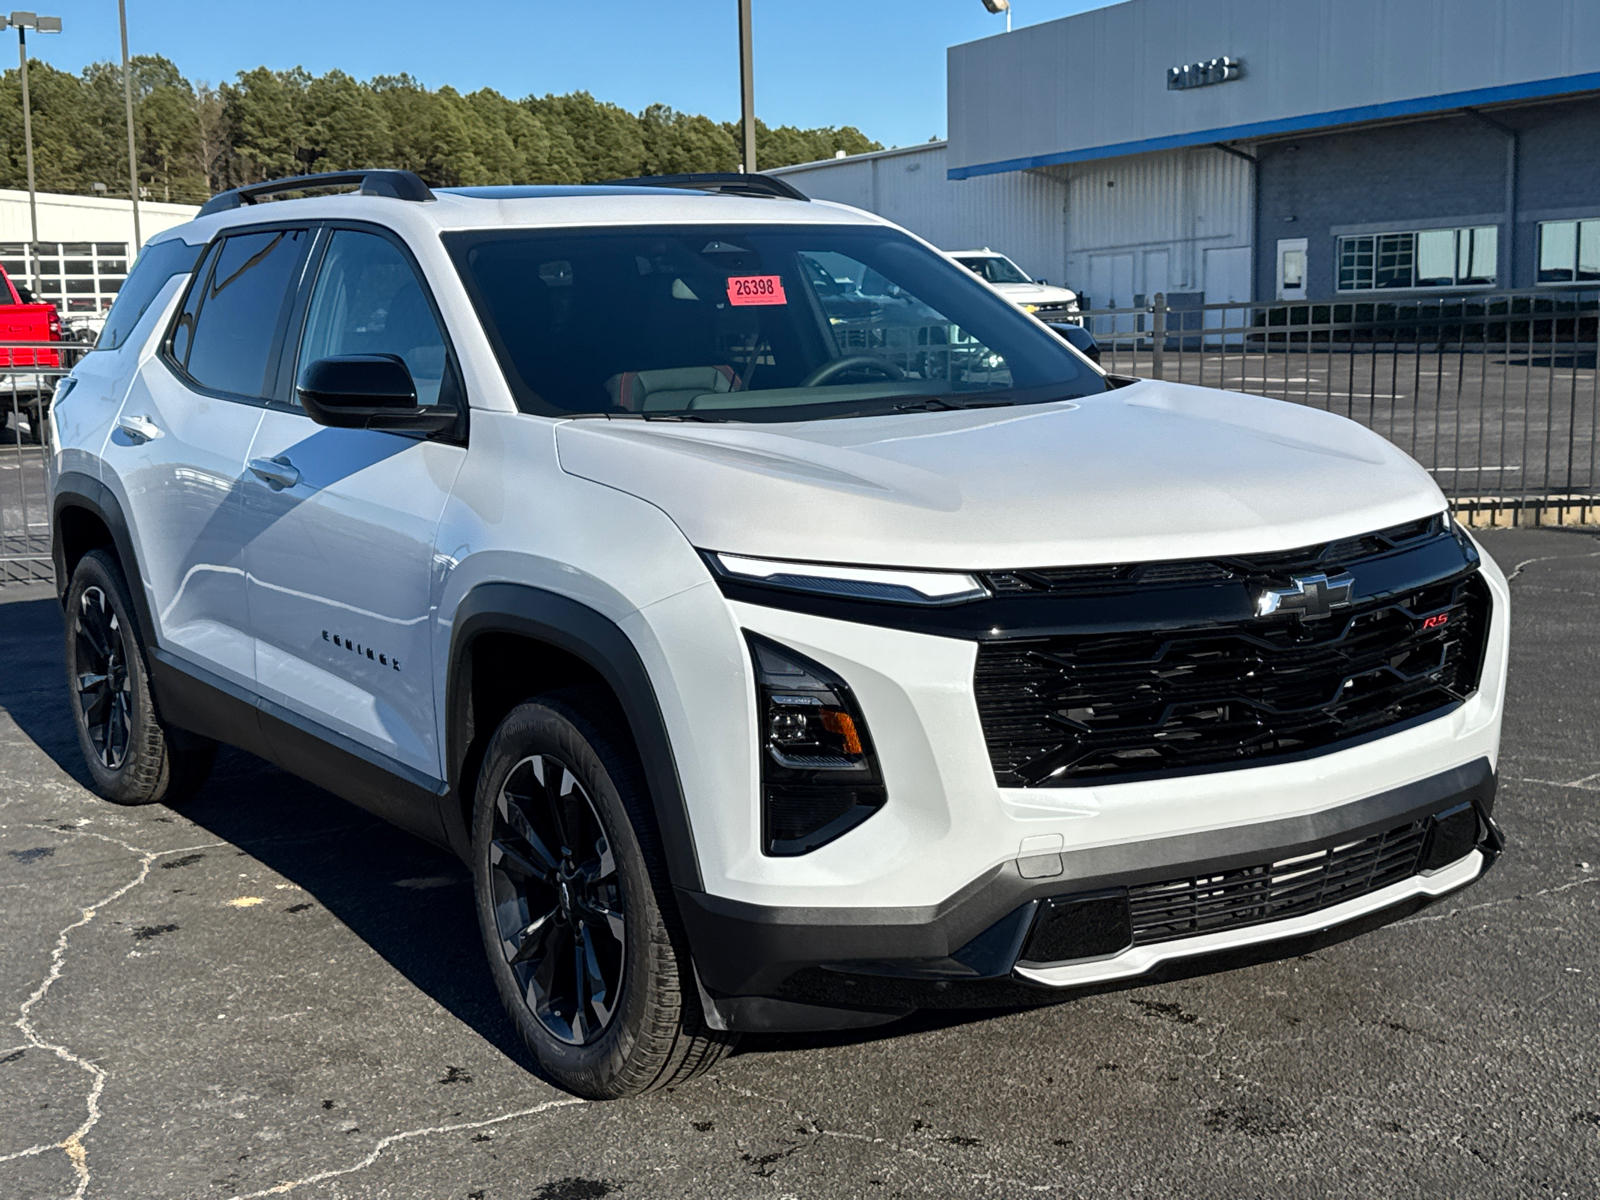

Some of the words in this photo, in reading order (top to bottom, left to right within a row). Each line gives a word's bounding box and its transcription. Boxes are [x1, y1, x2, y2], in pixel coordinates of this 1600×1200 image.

[735, 279, 774, 295] 26398
[1422, 613, 1448, 630] RS
[322, 629, 401, 672] EQUINOX
